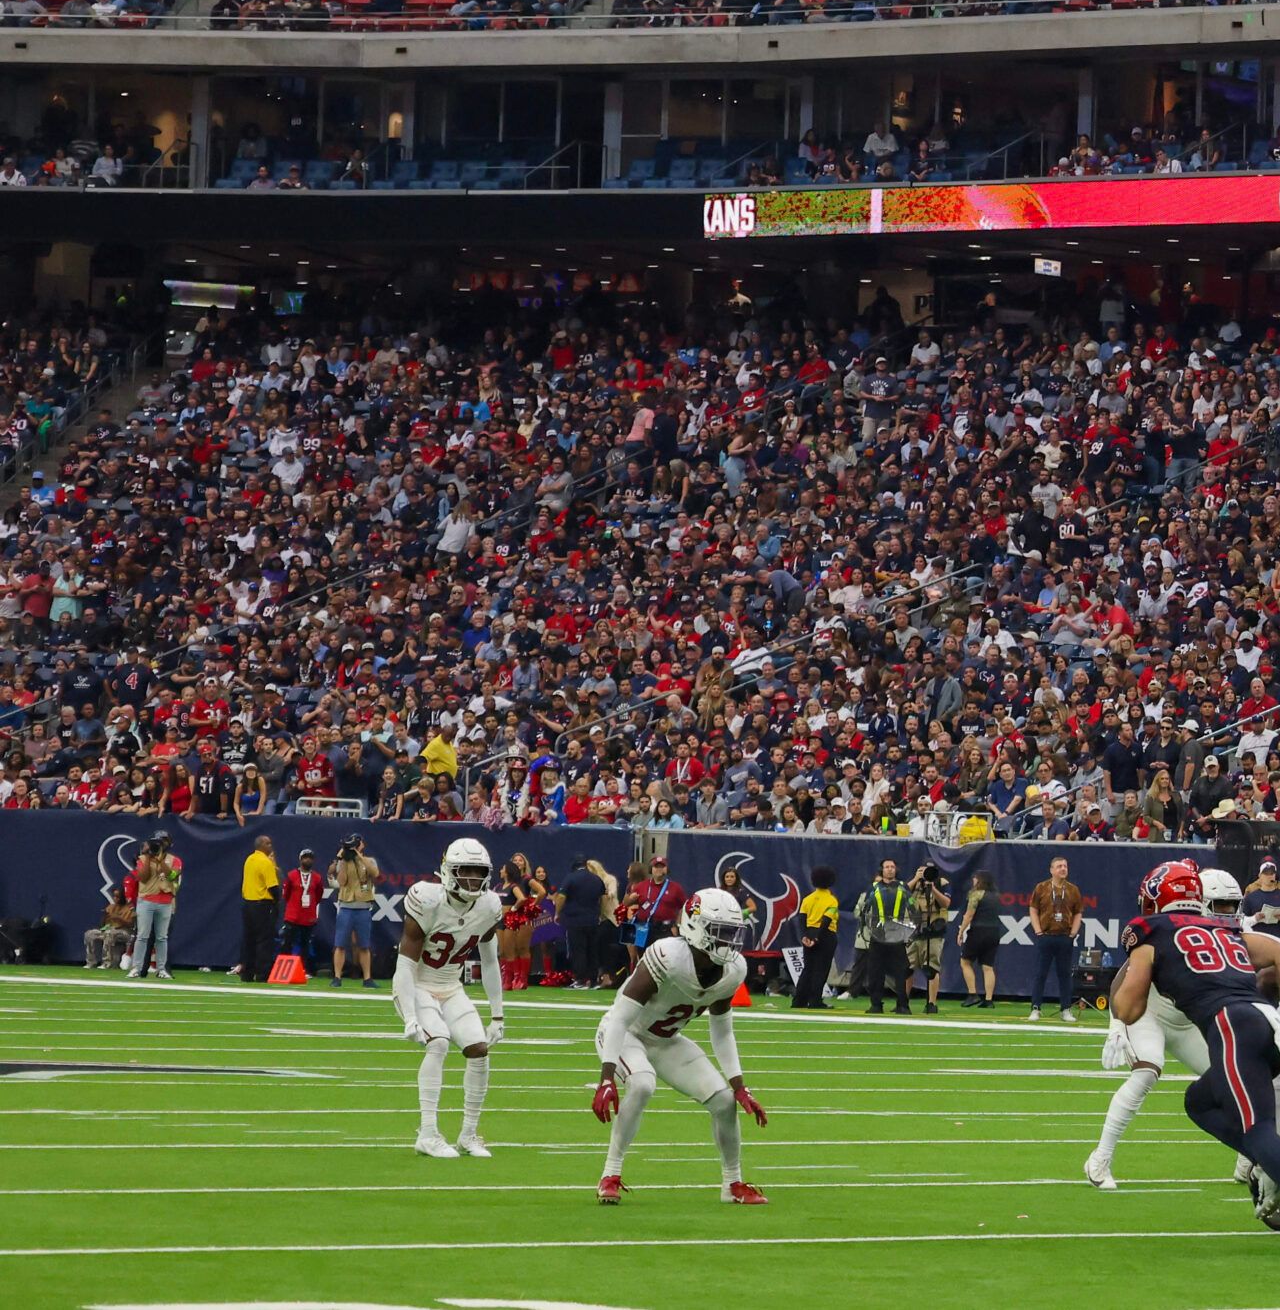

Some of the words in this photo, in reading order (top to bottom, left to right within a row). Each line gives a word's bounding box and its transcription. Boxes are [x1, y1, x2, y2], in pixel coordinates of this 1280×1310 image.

[303, 437, 321, 450] 99
[1059, 523, 1075, 538] 80
[125, 672, 138, 690] 4
[568, 769, 577, 780] 7
[199, 777, 213, 794] 51
[421, 932, 480, 970] 34
[1174, 924, 1257, 974] 86
[274, 959, 296, 978] 10
